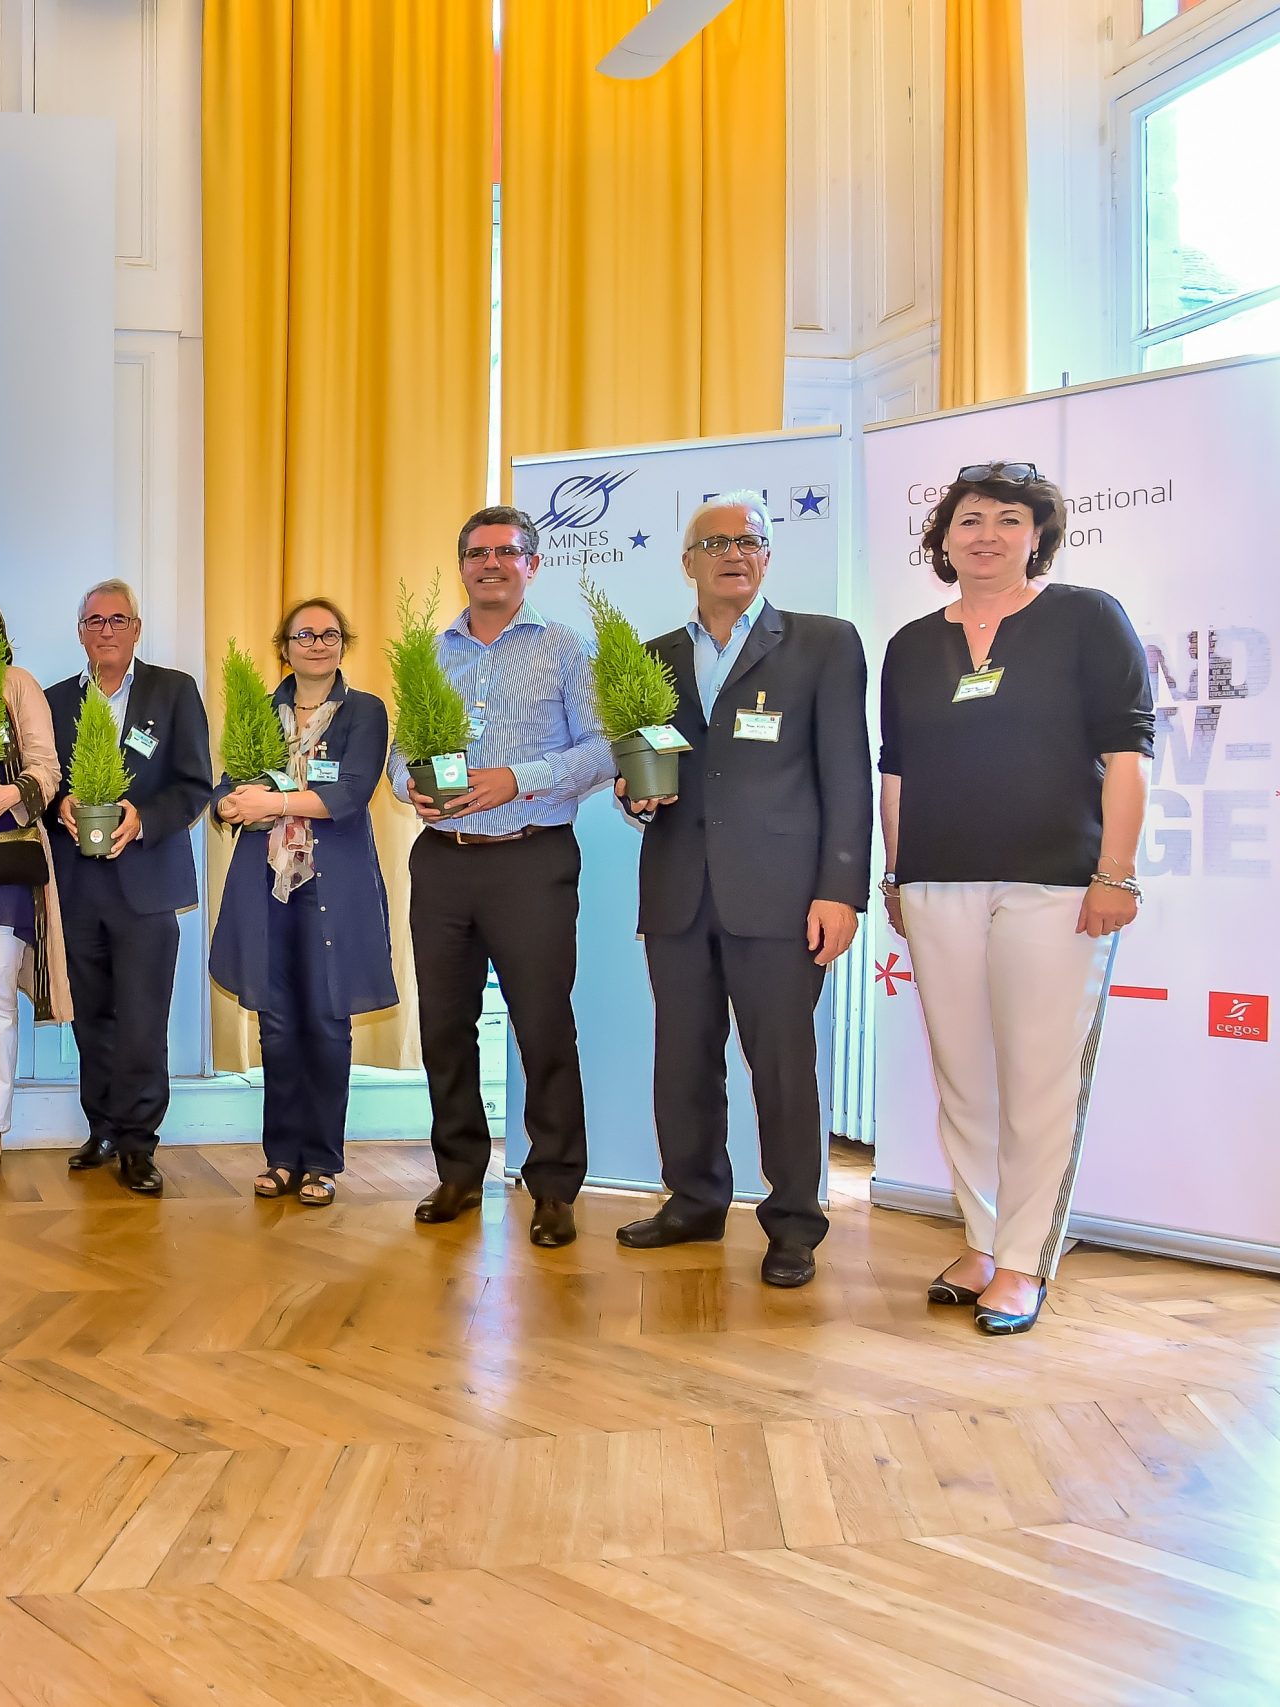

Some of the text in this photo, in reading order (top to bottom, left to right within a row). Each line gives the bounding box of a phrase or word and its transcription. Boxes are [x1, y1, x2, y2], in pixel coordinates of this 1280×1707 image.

[1063, 479, 1173, 514] national
[548, 530, 609, 550] MINES
[1215, 1021, 1261, 1038] cegos
